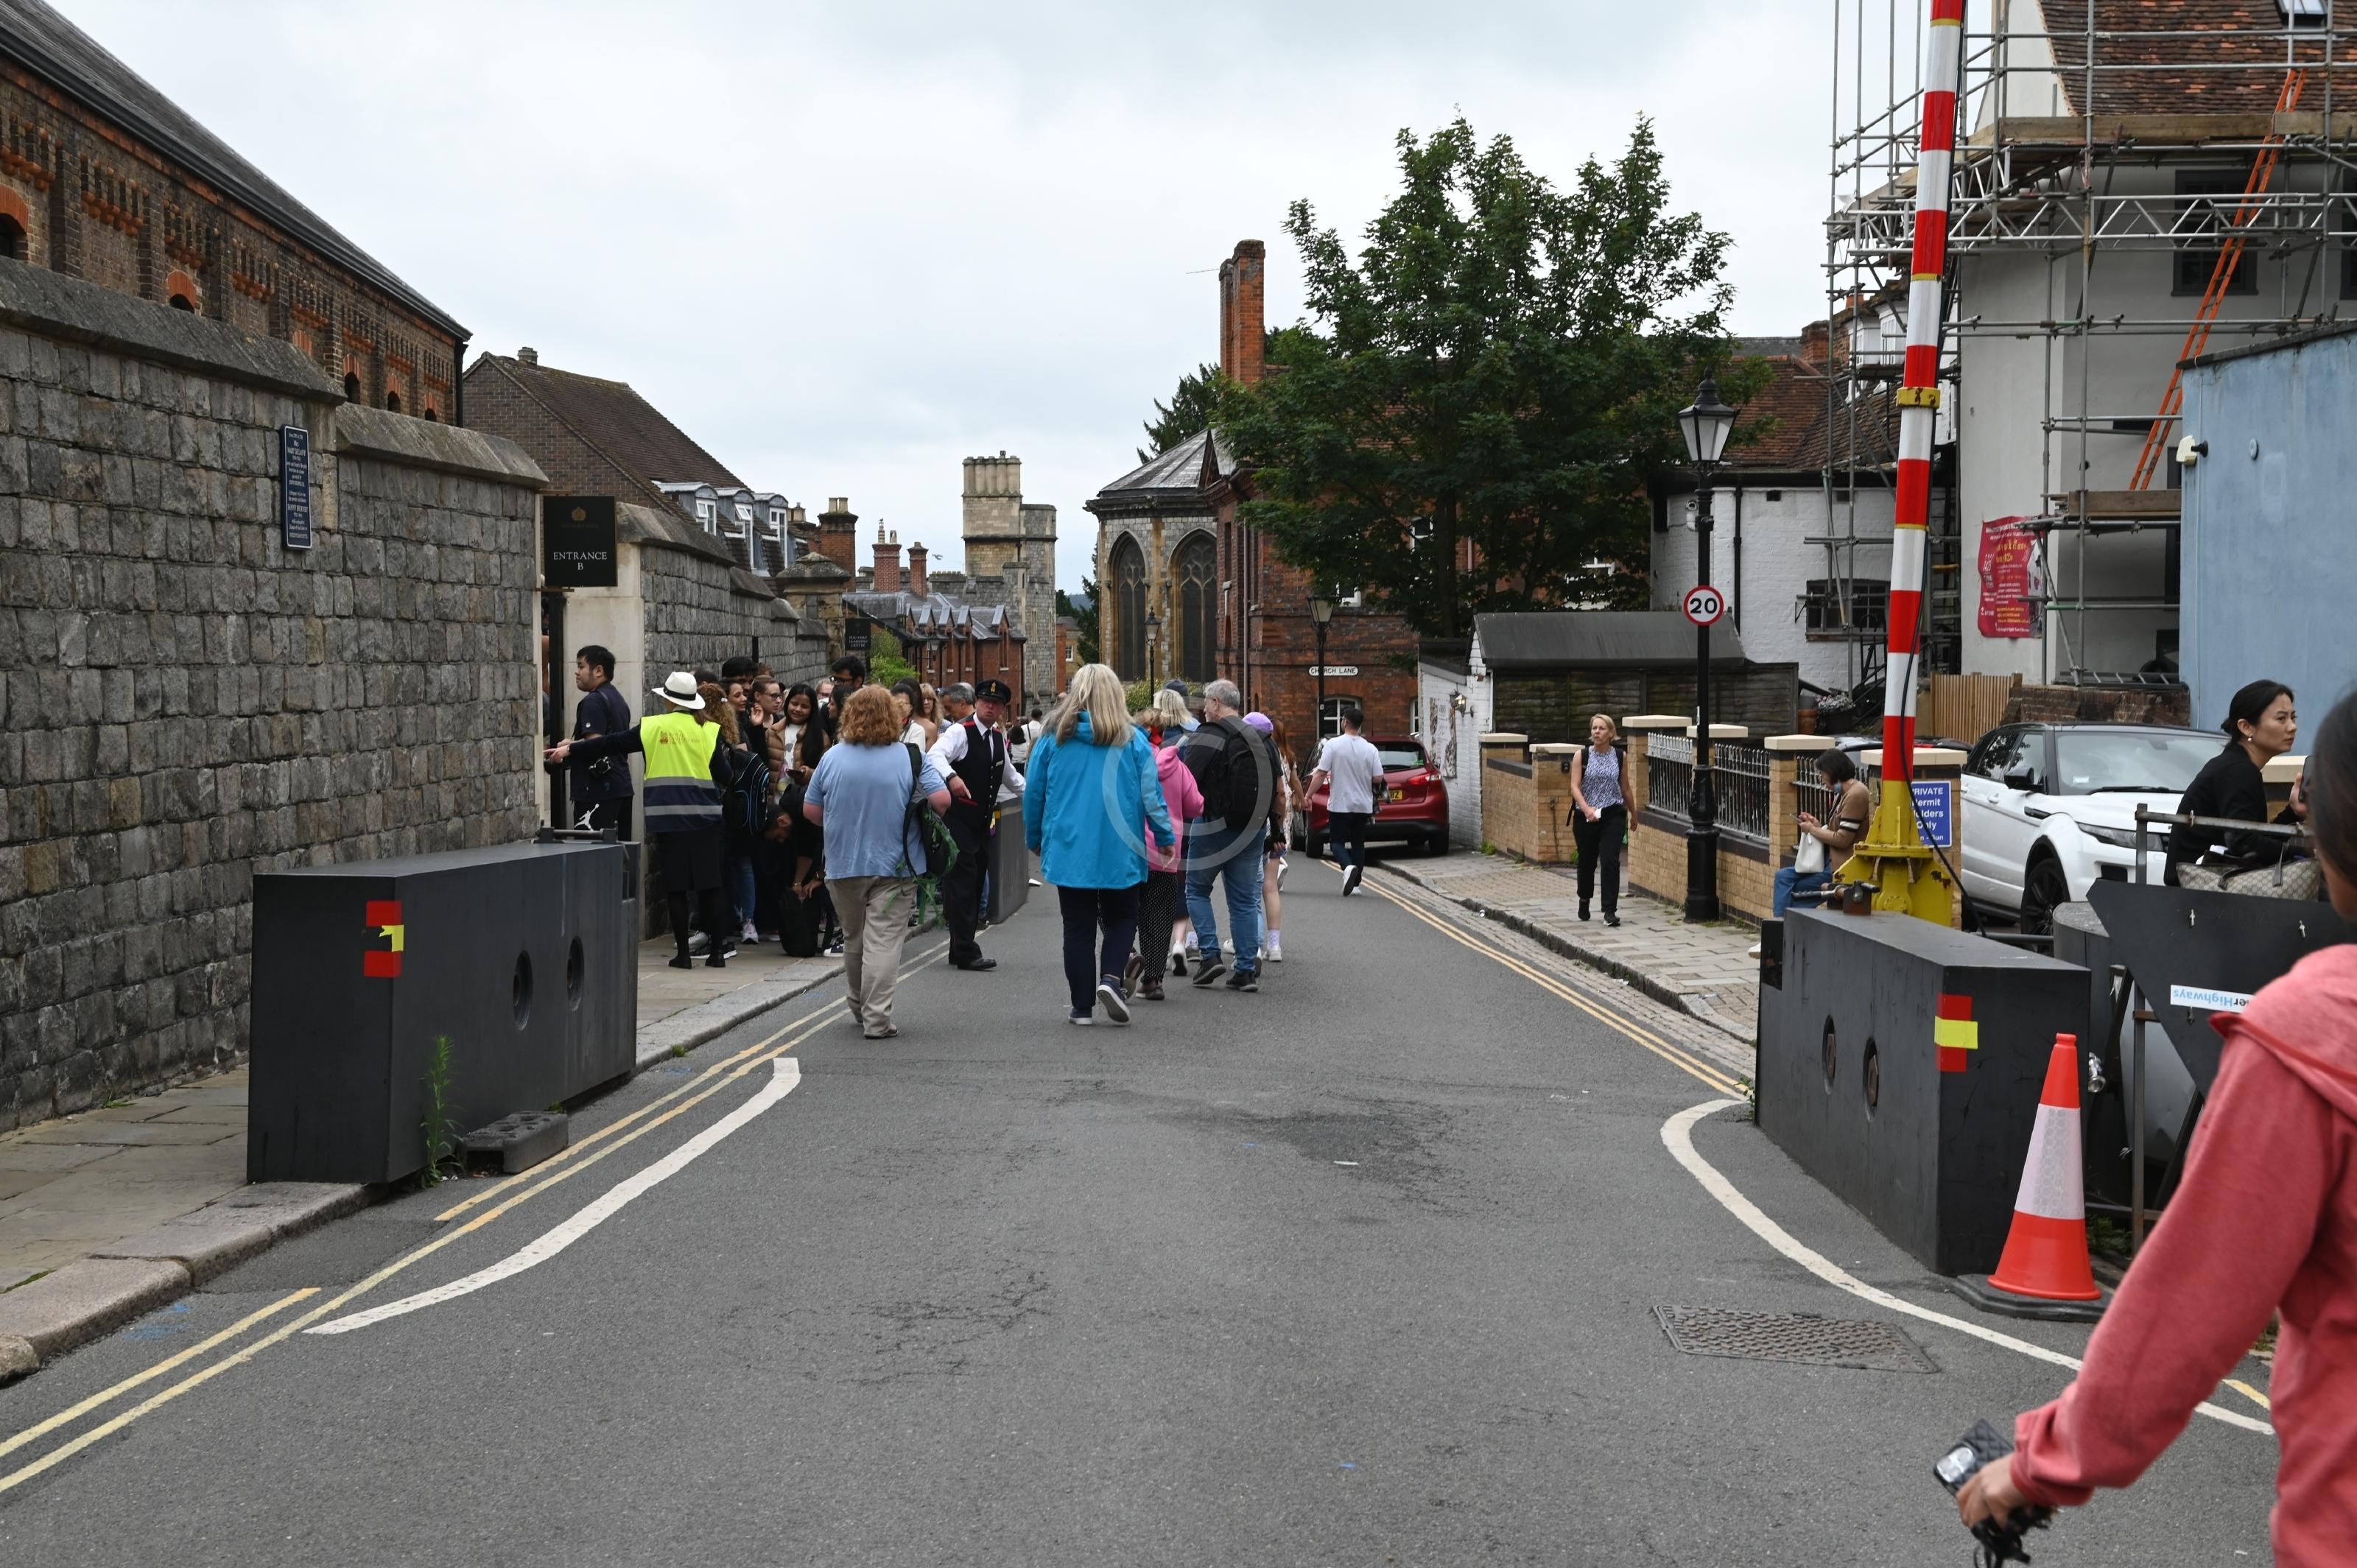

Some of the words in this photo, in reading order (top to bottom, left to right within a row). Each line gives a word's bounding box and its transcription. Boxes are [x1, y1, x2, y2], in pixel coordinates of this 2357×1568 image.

[553, 552, 608, 560] ENTRANCE
[577, 562, 584, 570] B
[1690, 597, 1718, 614] 20
